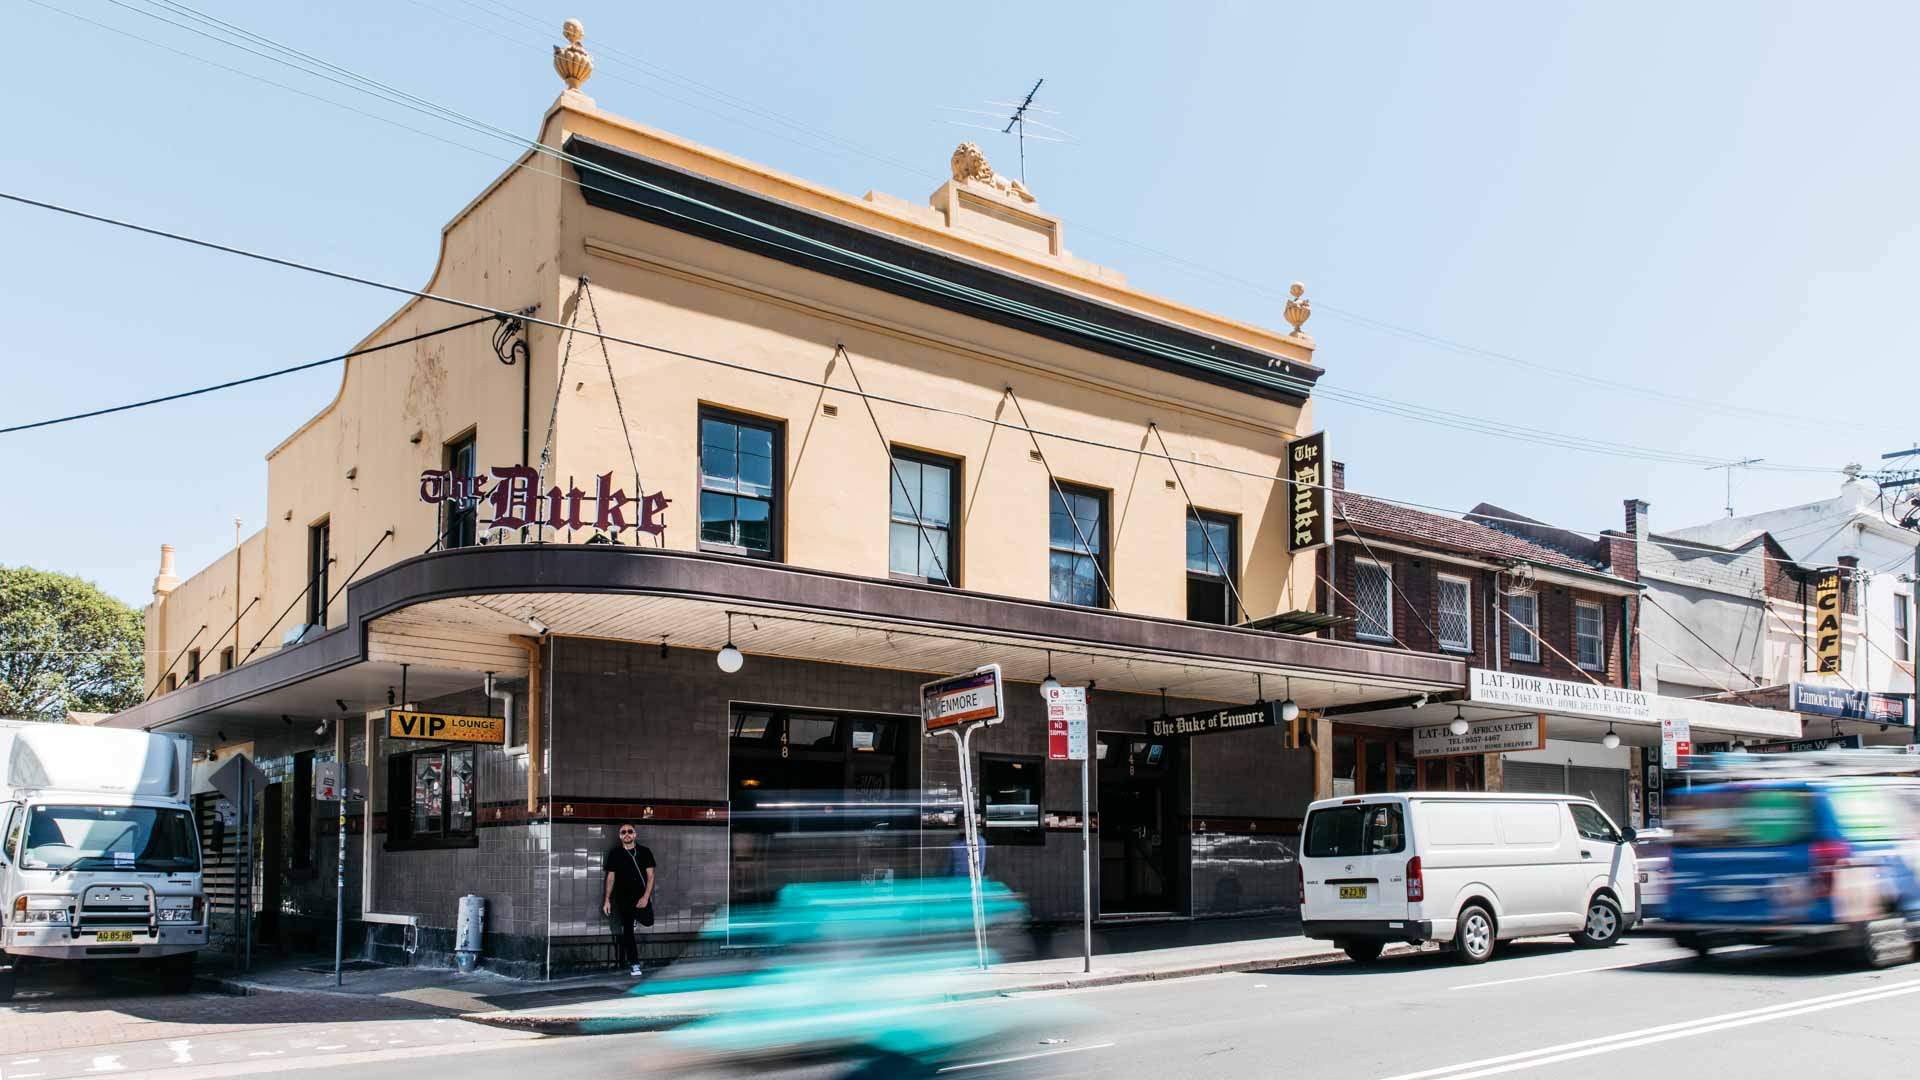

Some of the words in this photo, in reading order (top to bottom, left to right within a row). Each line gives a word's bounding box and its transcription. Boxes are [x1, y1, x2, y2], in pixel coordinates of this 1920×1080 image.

[1294, 444, 1318, 461] The
[420, 469, 488, 509] The
[489, 466, 669, 535] Duke
[1294, 462, 1319, 546] Duke
[1819, 593, 1838, 672] CAFE
[1480, 672, 1541, 693] LAT-DIOR
[1545, 682, 1600, 700] AFRICAN
[1603, 688, 1649, 706] EATERY
[1480, 688, 1499, 701] DINE
[1798, 686, 1828, 706] Enmore
[1828, 691, 1845, 710] Fine
[941, 693, 978, 713] ENMORE
[398, 715, 446, 736] VIP
[451, 719, 496, 730] LOUNGE
[1153, 720, 1175, 736] The
[1176, 714, 1206, 733] Duke
[1208, 715, 1218, 728] of
[1219, 710, 1265, 728] Enmore
[1472, 725, 1503, 735] AFRICAN
[1504, 722, 1534, 732] EATERY
